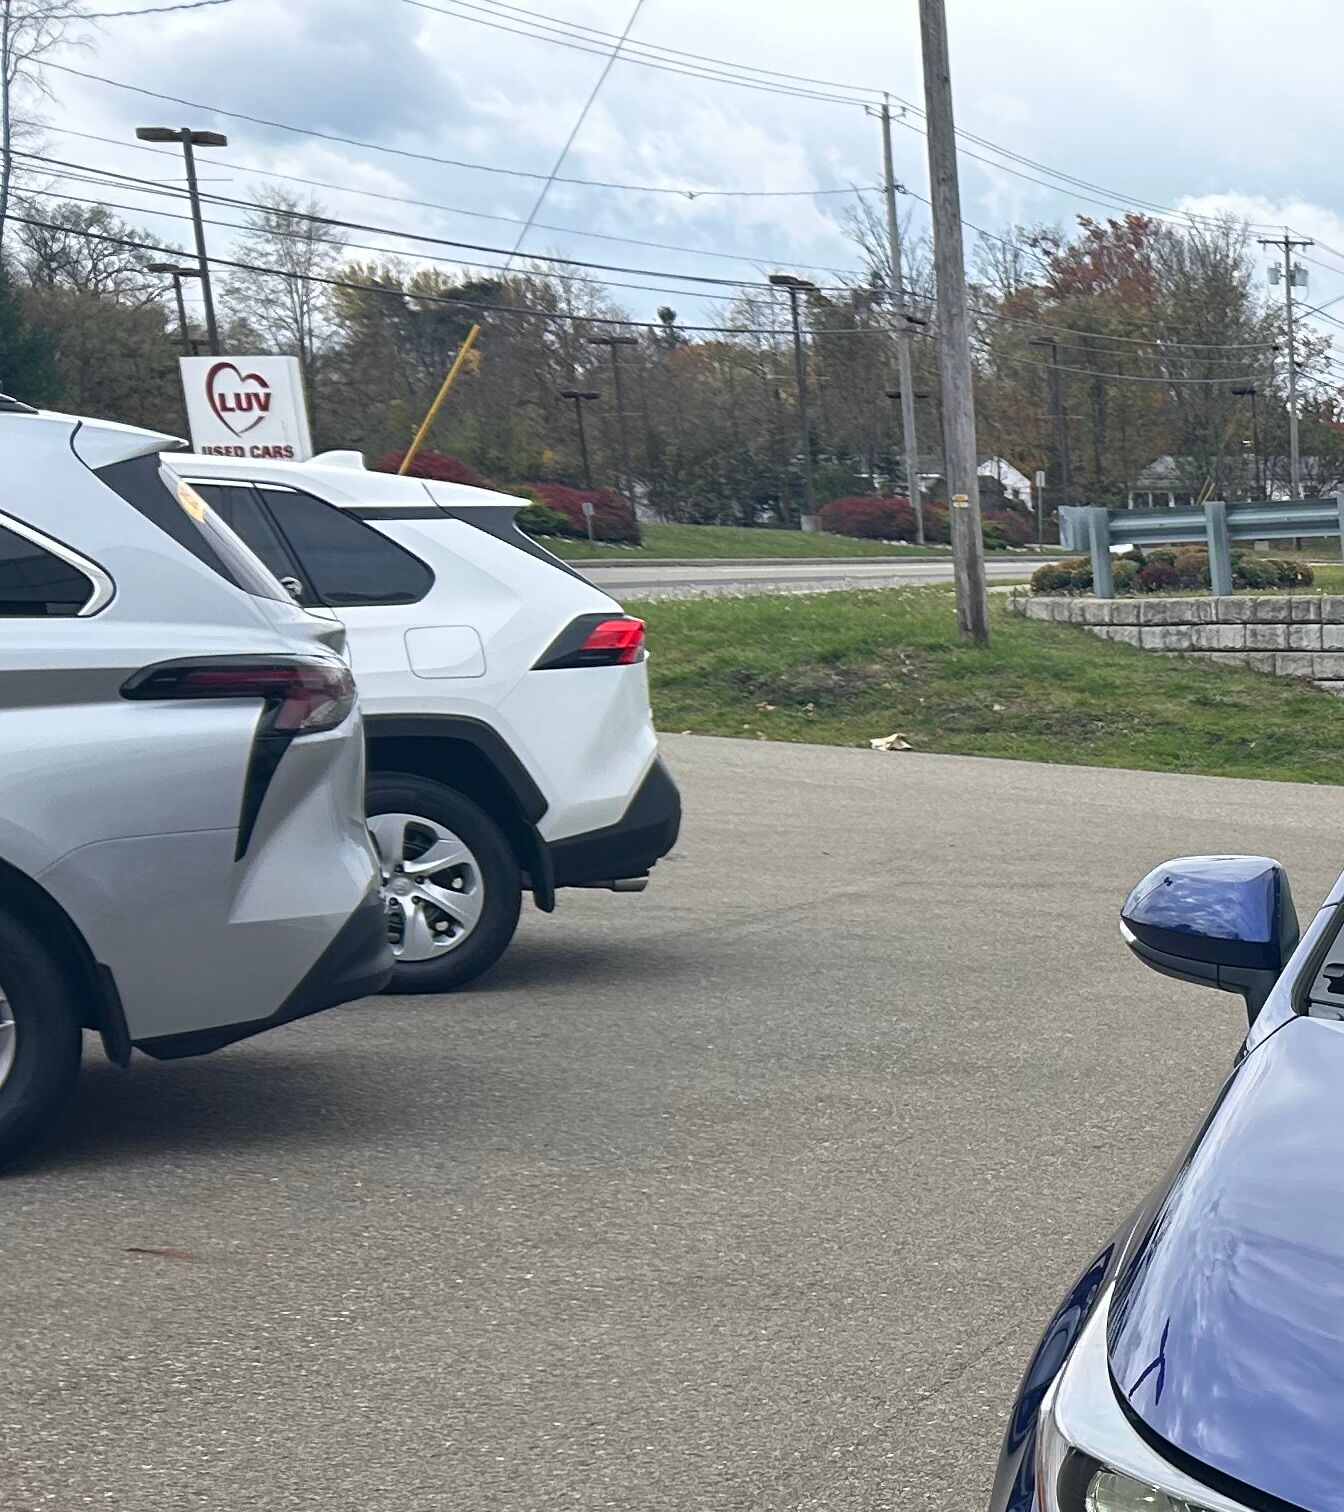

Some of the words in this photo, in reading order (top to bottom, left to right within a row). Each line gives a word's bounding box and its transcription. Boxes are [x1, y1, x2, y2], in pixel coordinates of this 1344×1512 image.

[218, 392, 271, 412] LUV
[202, 446, 246, 458] USED
[249, 444, 295, 459] CARS
